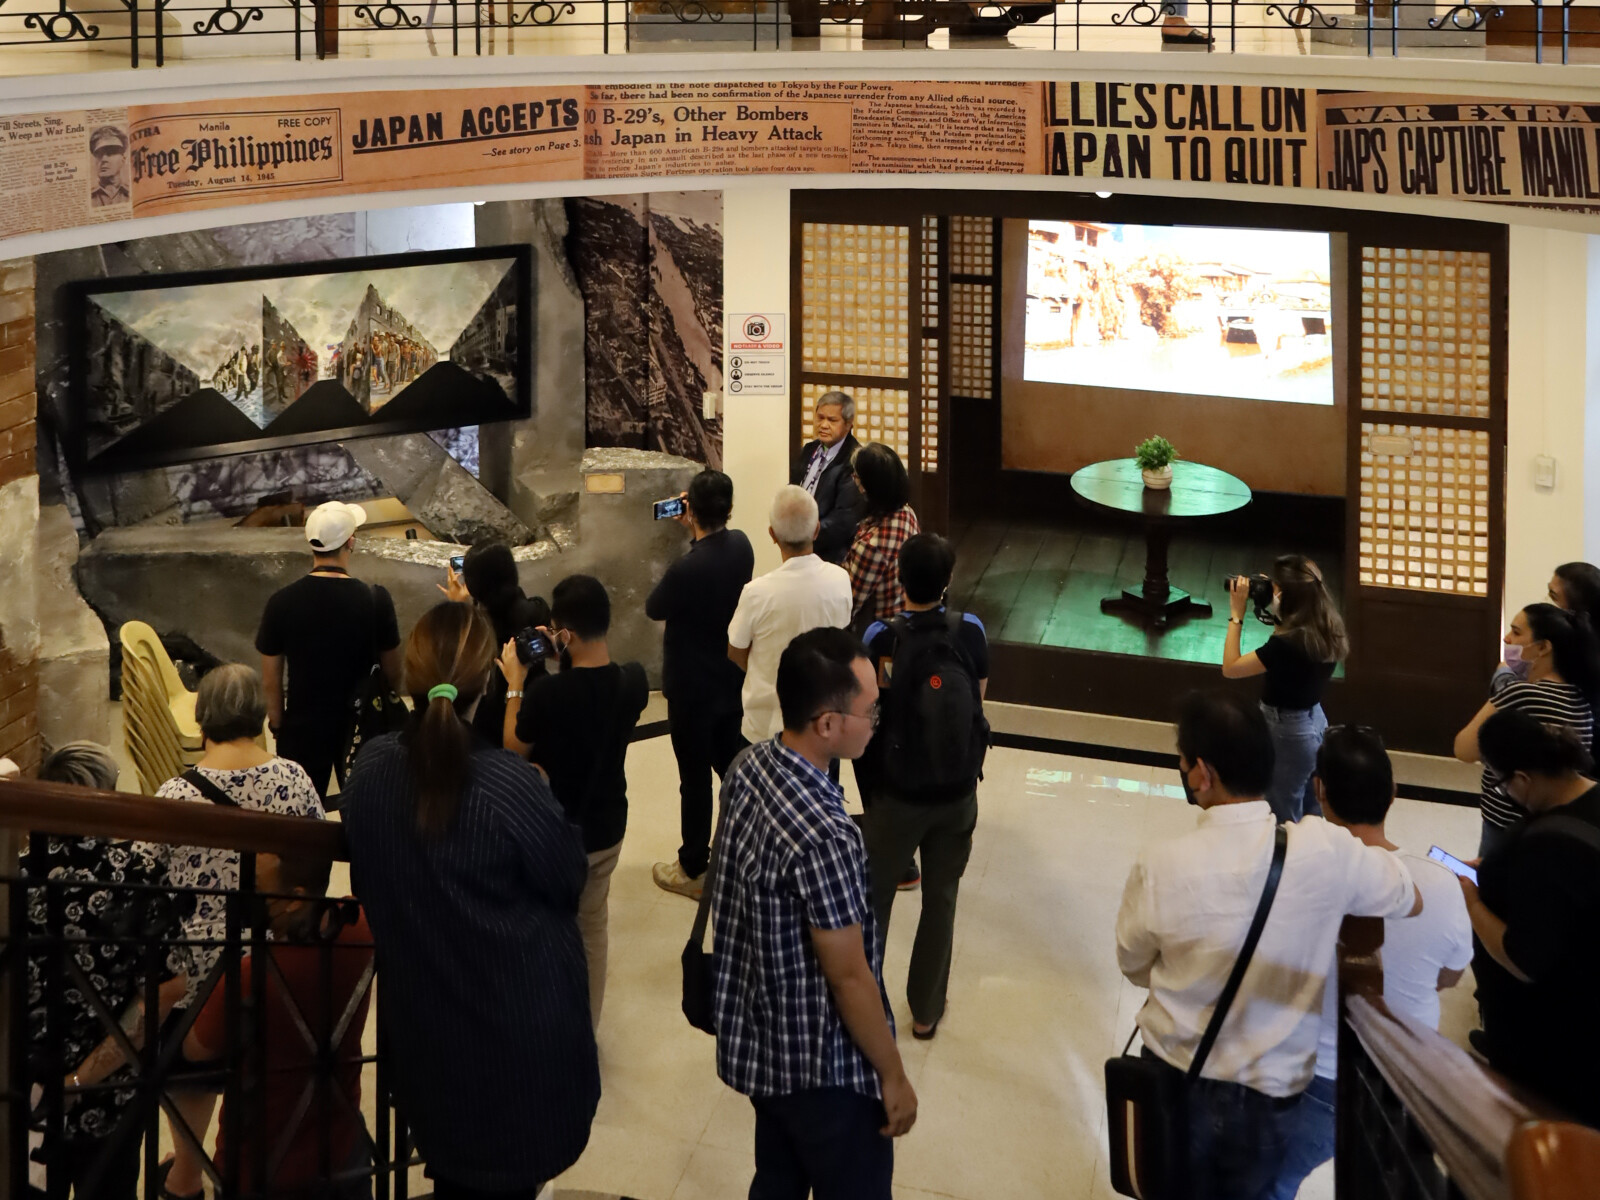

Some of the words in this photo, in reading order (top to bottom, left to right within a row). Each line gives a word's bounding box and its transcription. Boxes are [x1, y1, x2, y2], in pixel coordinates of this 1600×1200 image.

[781, 81, 808, 89] Tokyo
[811, 82, 820, 90] by
[839, 82, 857, 90] Four
[861, 83, 893, 91] Powers.
[601, 91, 617, 100] far,
[620, 90, 645, 99] there
[649, 90, 667, 98] had
[671, 90, 693, 98] been
[803, 91, 841, 99] Japanese
[927, 94, 954, 102] Allied
[956, 95, 984, 103] official
[1044, 81, 1157, 129] LLIES
[1165, 83, 1254, 131] CALL
[1261, 86, 1306, 132] ON
[1341, 105, 1435, 123] WAR
[1458, 104, 1592, 123] EXTRA
[13, 120, 41, 129] Streets,
[44, 117, 63, 126] Sing,
[278, 118, 300, 128] FREE
[305, 117, 331, 127] COPY
[352, 112, 443, 148] JAPAN
[460, 98, 579, 137] ACCEPTS
[603, 108, 664, 126] B-29's,
[674, 106, 726, 122] Other
[737, 105, 808, 120] Bombers
[9, 131, 32, 140] Weep
[46, 127, 63, 136] War
[66, 124, 84, 133] Ends
[200, 122, 230, 132] Manila
[611, 129, 666, 148] Japan
[675, 127, 692, 142] in
[702, 125, 758, 143] Heavy
[768, 126, 823, 140] Attack
[510, 145, 531, 155] story
[549, 142, 570, 153] Page
[573, 139, 581, 148] 3.
[131, 145, 180, 183] Free
[181, 134, 333, 173] Philippines
[1045, 132, 1151, 179] APAN
[1165, 135, 1211, 182] TO
[1225, 136, 1307, 187] QUIT
[1328, 127, 1388, 194] JAPS
[1398, 126, 1511, 195] CAPTURE
[1518, 126, 1600, 199] MANIL
[167, 179, 203, 189] Tuesday,
[208, 175, 236, 185] August
[241, 175, 252, 183] 14,
